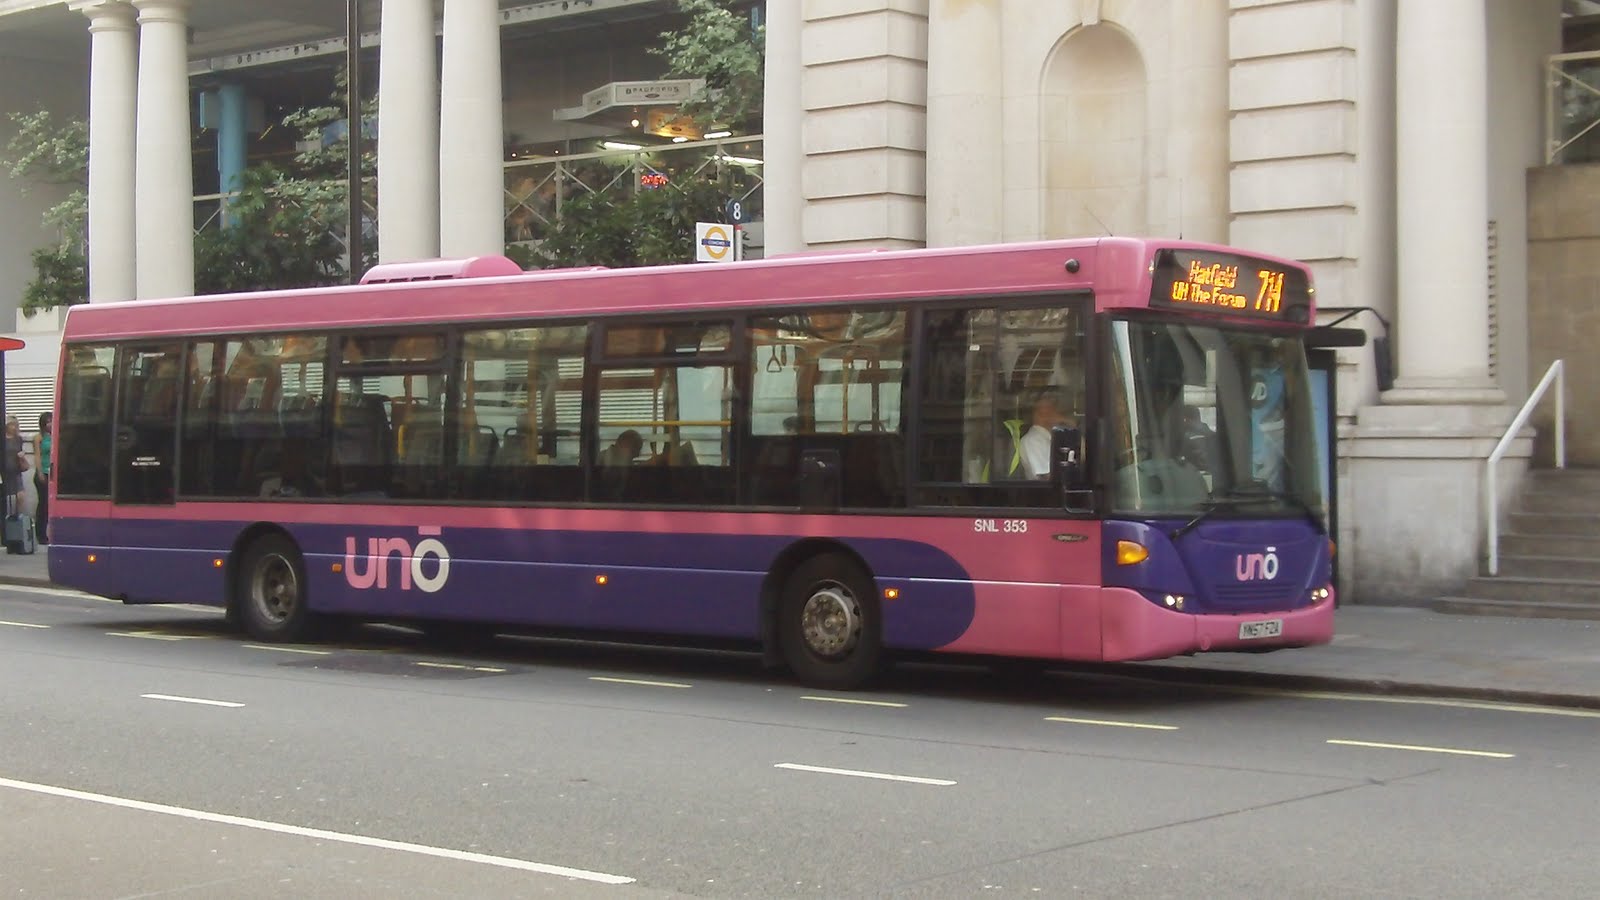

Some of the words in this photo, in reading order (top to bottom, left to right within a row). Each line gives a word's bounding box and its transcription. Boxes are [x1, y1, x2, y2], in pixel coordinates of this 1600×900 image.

[733, 202, 742, 220] 8
[1189, 260, 1238, 288] Hatfield
[1191, 283, 1211, 303] The
[1211, 287, 1247, 309] Forum
[1255, 270, 1284, 312] 7H
[974, 519, 999, 532] SNL
[1003, 520, 1027, 533] 353
